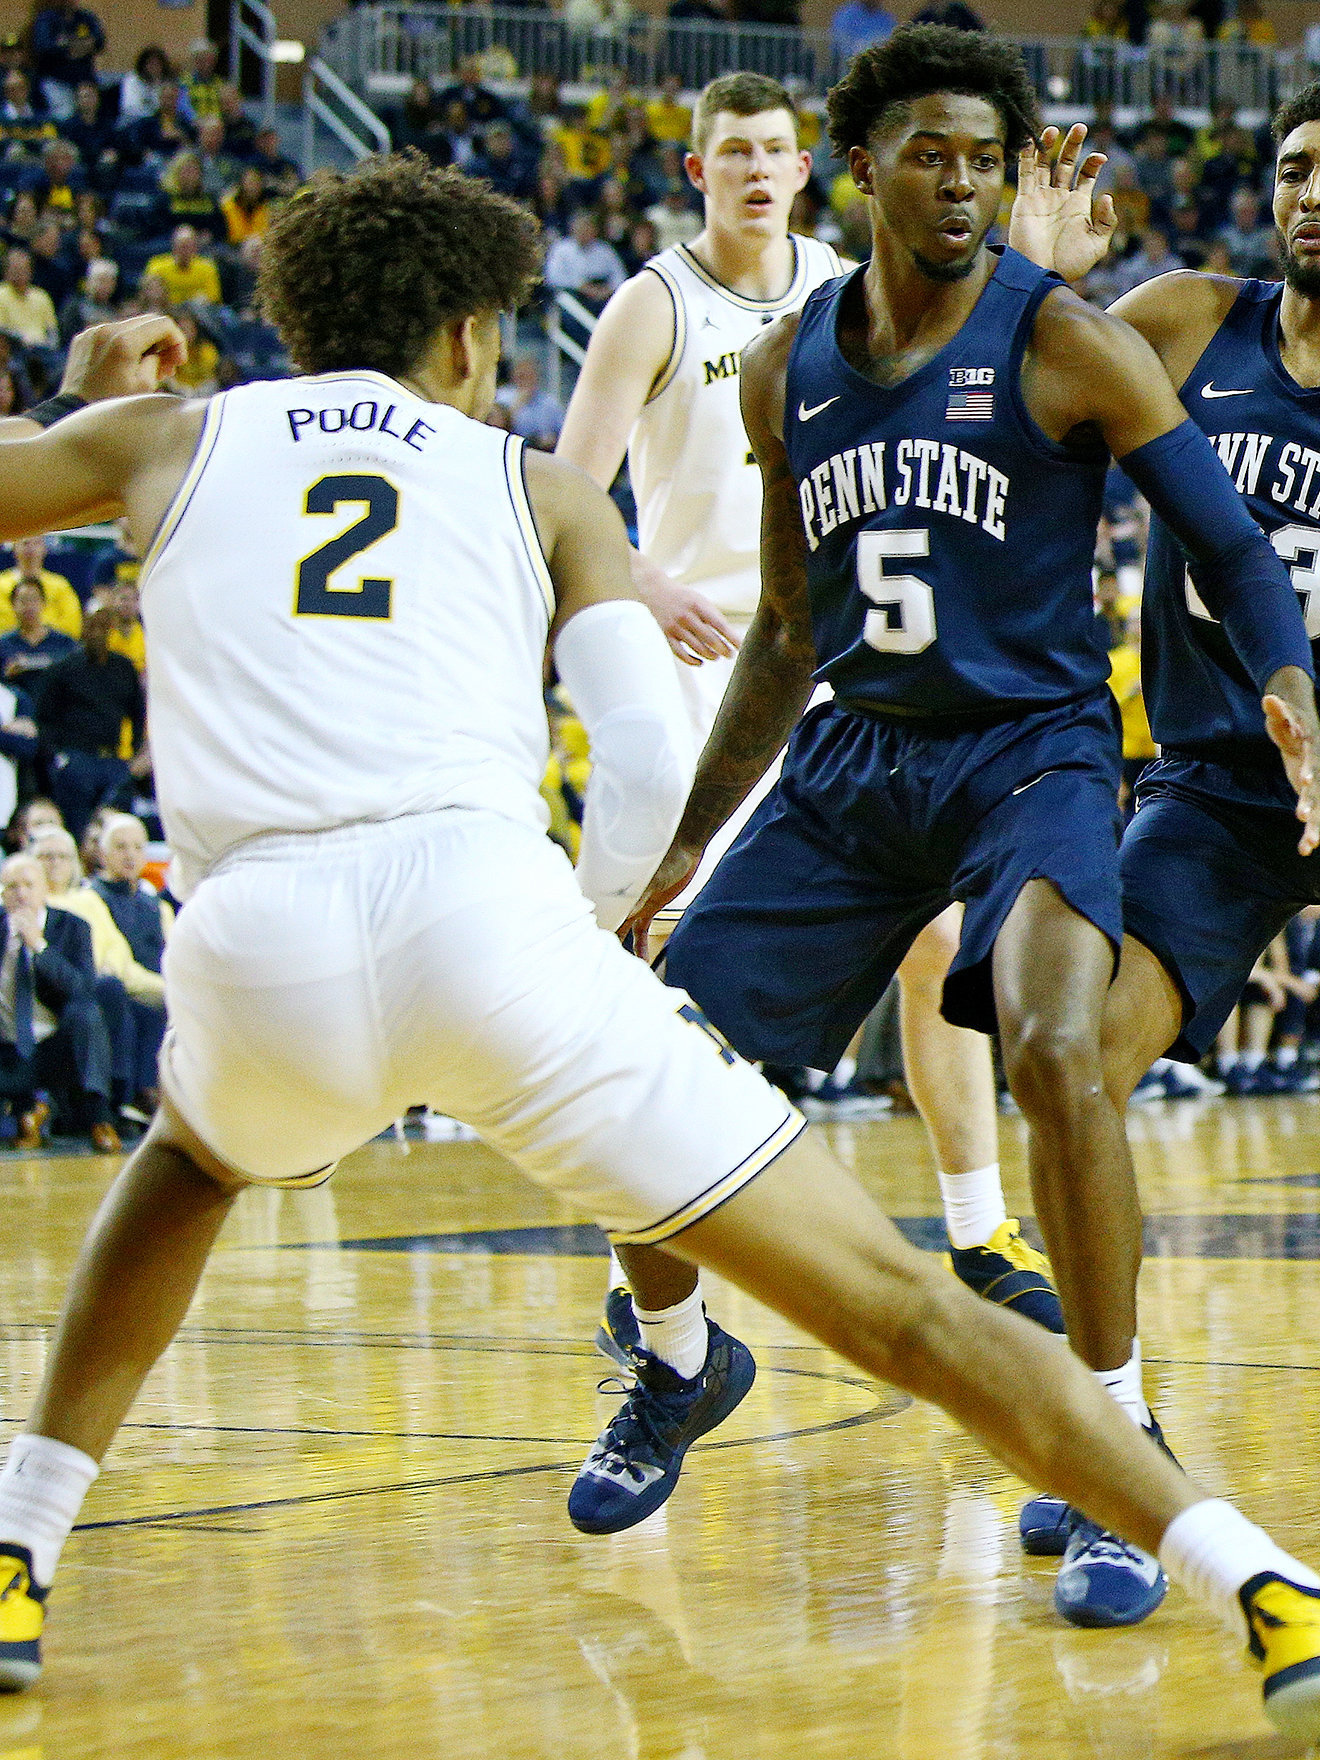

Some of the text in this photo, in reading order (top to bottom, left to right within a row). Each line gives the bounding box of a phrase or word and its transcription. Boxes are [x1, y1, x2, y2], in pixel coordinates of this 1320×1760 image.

[287, 401, 437, 452] POOLE
[1207, 433, 1273, 495] NN
[293, 472, 401, 621] 2
[799, 438, 1010, 552] PENN STATE
[857, 528, 938, 655] 5
